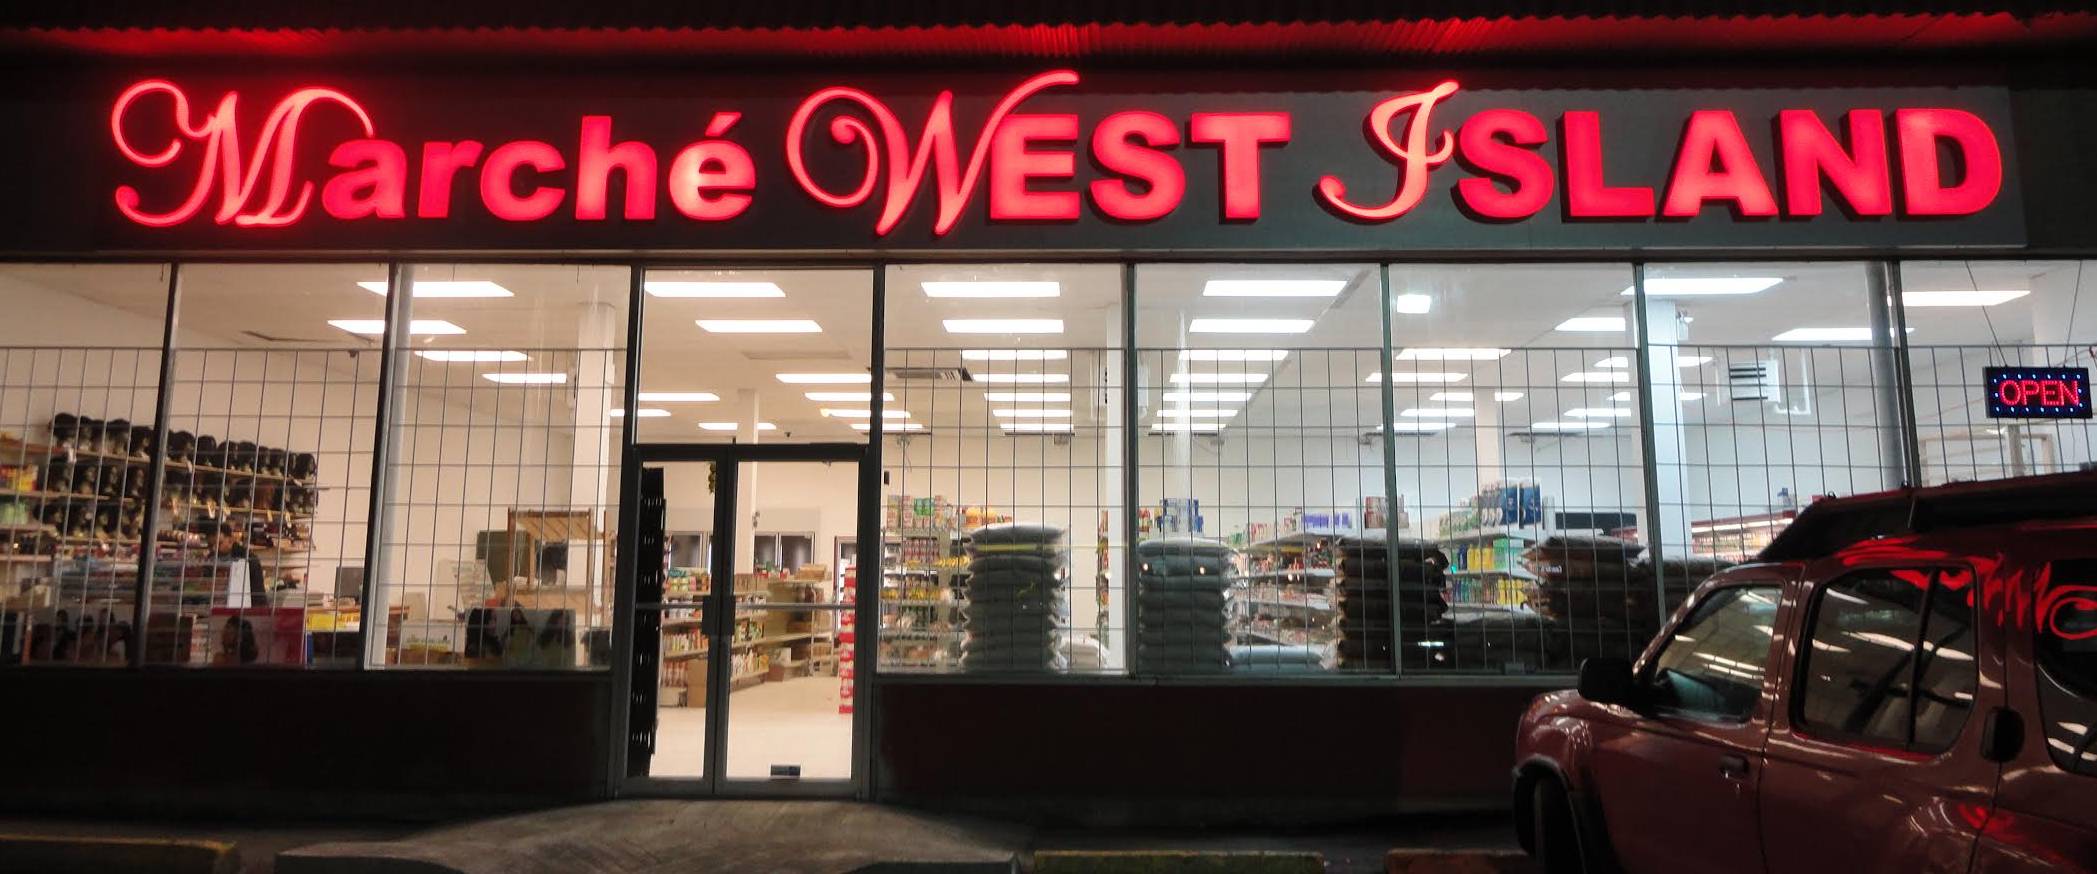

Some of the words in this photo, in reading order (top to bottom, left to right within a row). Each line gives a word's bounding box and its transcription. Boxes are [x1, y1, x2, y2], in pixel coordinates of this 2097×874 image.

[110, 79, 757, 228] Marché
[785, 70, 1292, 236] WEST
[1319, 80, 2003, 221] ISLAND
[1999, 379, 2081, 406] OPEN
